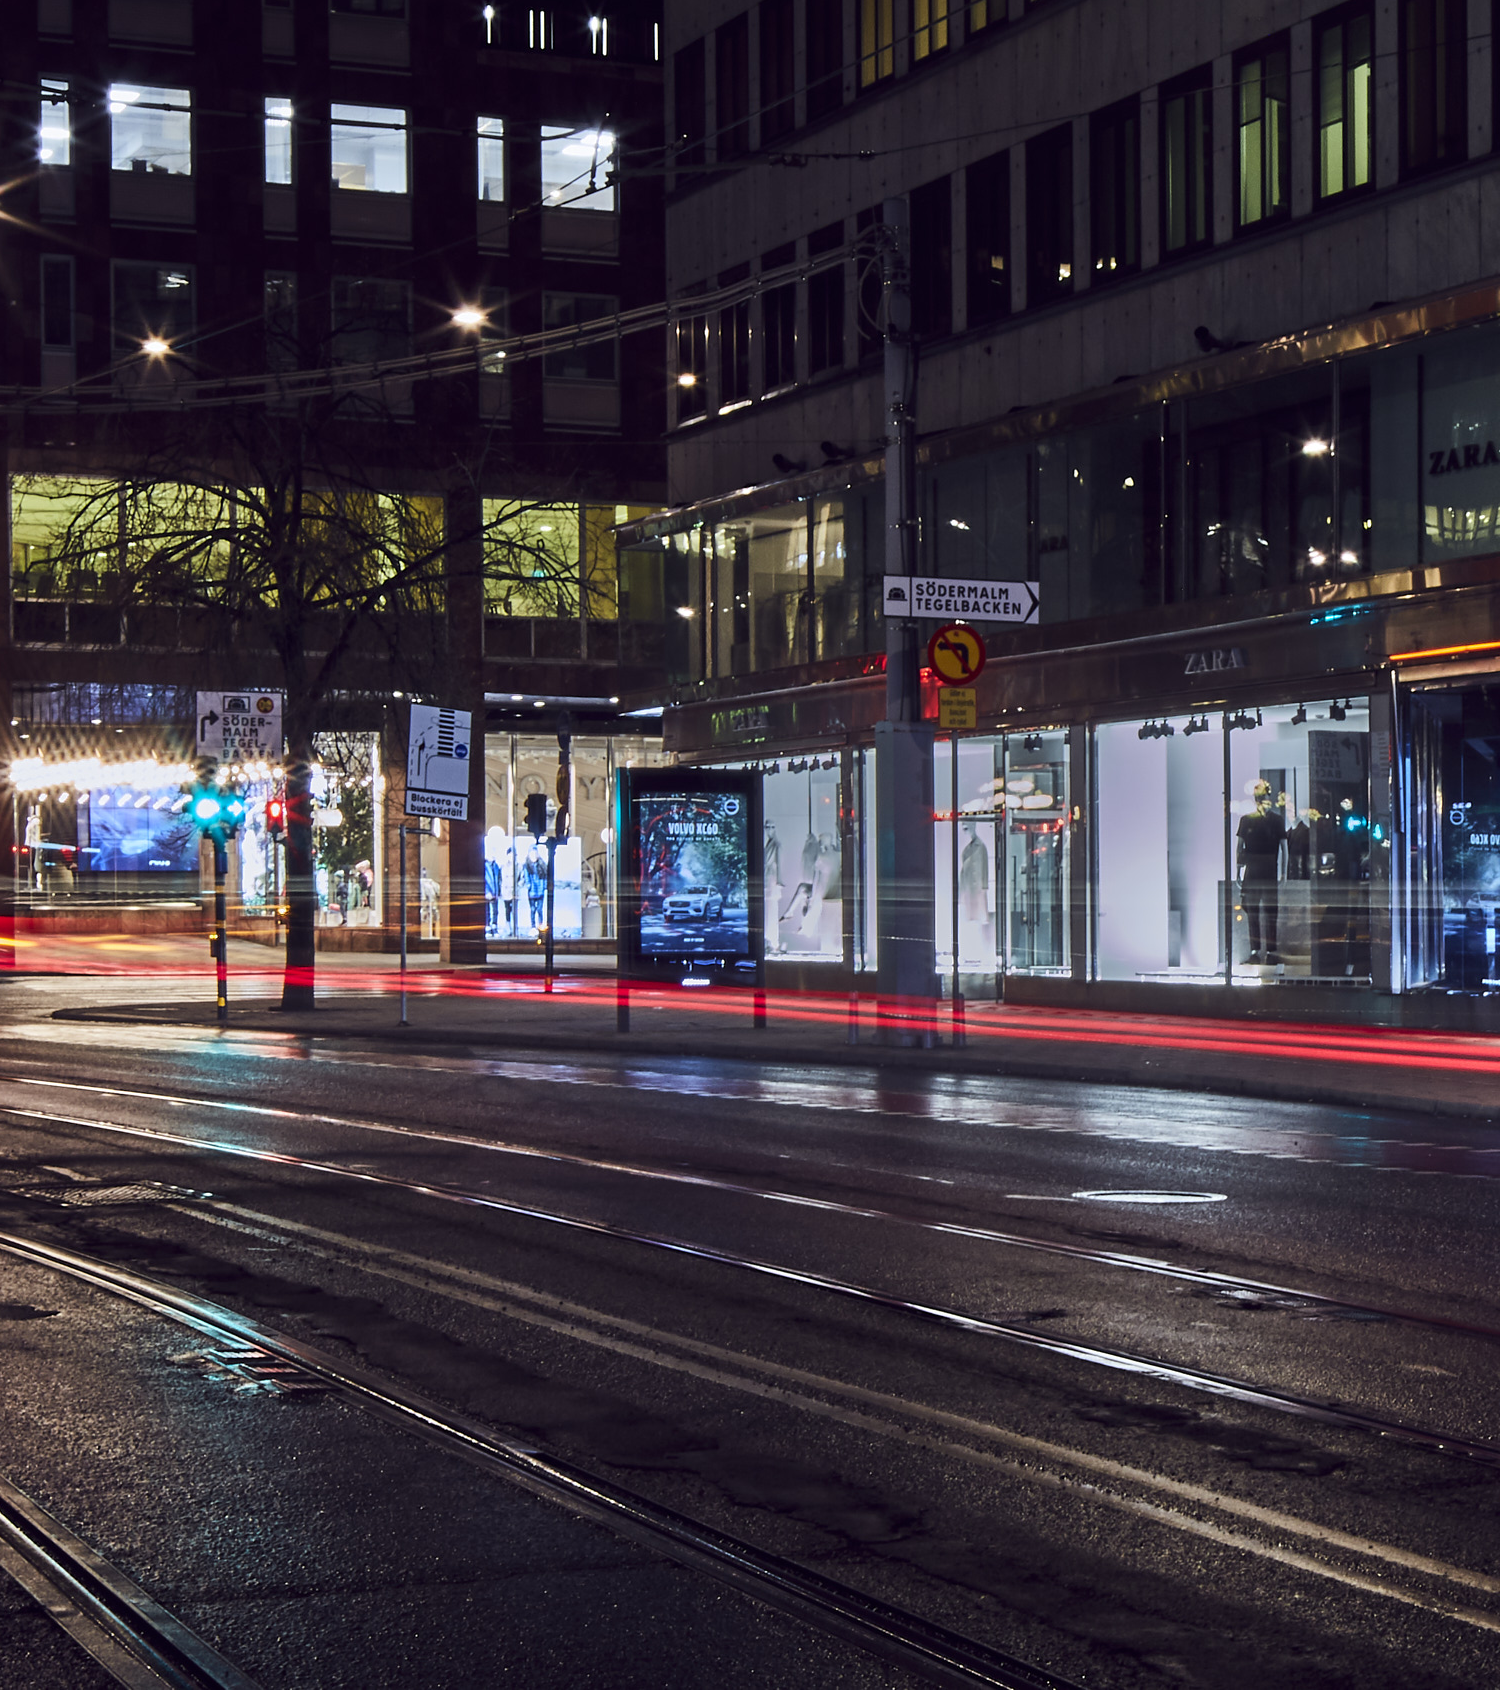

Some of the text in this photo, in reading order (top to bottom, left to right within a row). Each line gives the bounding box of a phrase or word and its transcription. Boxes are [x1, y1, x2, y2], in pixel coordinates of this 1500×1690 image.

[1428, 439, 1500, 476] ZARA
[1039, 535, 1069, 553] ARA
[915, 581, 1009, 600] SÖDERMALM
[915, 598, 1022, 615] TEGELBACKEN
[1183, 647, 1245, 675] ZARA
[222, 715, 272, 727] SÖDER-
[222, 727, 259, 737] MALM
[222, 738, 267, 748] TEGEL-
[411, 794, 463, 808] Blockera ej
[411, 805, 462, 817] busskörfält
[668, 822, 719, 835] VOLVO XC60
